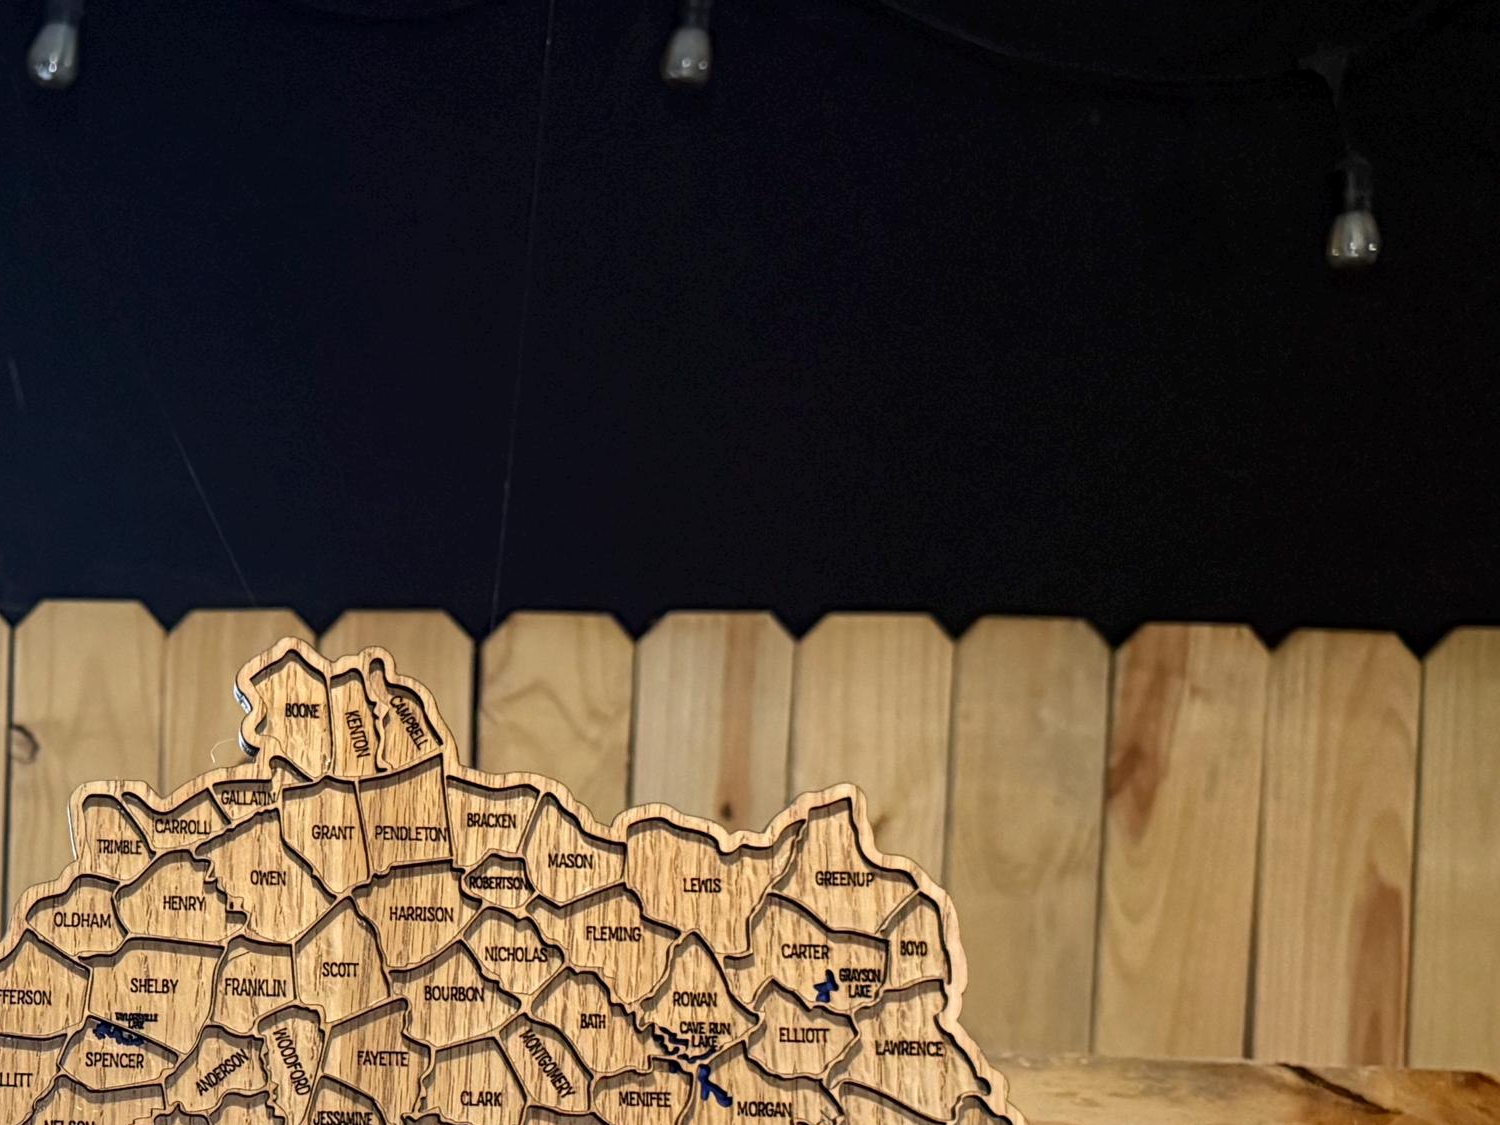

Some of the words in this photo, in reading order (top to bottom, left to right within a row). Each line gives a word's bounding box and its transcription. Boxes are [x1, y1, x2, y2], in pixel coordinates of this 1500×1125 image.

[285, 703, 320, 718] BOONE
[389, 695, 428, 750] CAMPBELL
[345, 710, 370, 758] KENTON
[220, 790, 275, 806] GALLATIN
[155, 819, 210, 835] CARROLL
[467, 813, 516, 829] BRACKEN
[312, 825, 355, 840] GRANT
[375, 825, 448, 842] PENDLETON
[97, 839, 142, 855] TRIMBLE
[548, 854, 592, 869] MASON
[250, 870, 286, 886] OWEN
[469, 876, 528, 890] ROBERTSON
[683, 878, 721, 893] LEWIS
[815, 871, 875, 887] GREENUP
[163, 896, 205, 911] HENRY
[53, 912, 111, 928] OLDHAM
[390, 906, 454, 922] HARRISON
[586, 926, 641, 942] FLEMING
[485, 947, 548, 962] NICHOLAS
[781, 944, 830, 960] CARTER
[900, 940, 927, 956] BOYD
[322, 962, 359, 978] SCOTT
[130, 978, 178, 994] SHELBY
[224, 978, 287, 997] FRANKLIN
[425, 986, 484, 1002] BOURBON
[673, 991, 717, 1007] ROWAN
[580, 1014, 606, 1029] BATH
[679, 1021, 706, 1034] CAVE
[709, 1022, 730, 1035] RUN
[691, 1035, 718, 1048] LAKE
[779, 1027, 830, 1043] ELLIOTT
[875, 1040, 943, 1057] LAWRENCE
[85, 1052, 144, 1068] SPENCER
[272, 1027, 312, 1095] WOODFORD
[357, 1050, 409, 1067] FAYETTE
[519, 1029, 575, 1099] MONTGOMERY
[196, 1048, 249, 1096] ANDERSON
[460, 1091, 502, 1107] CLARK
[619, 1091, 671, 1108] MENIFEE
[737, 1101, 792, 1117] MORGAN
